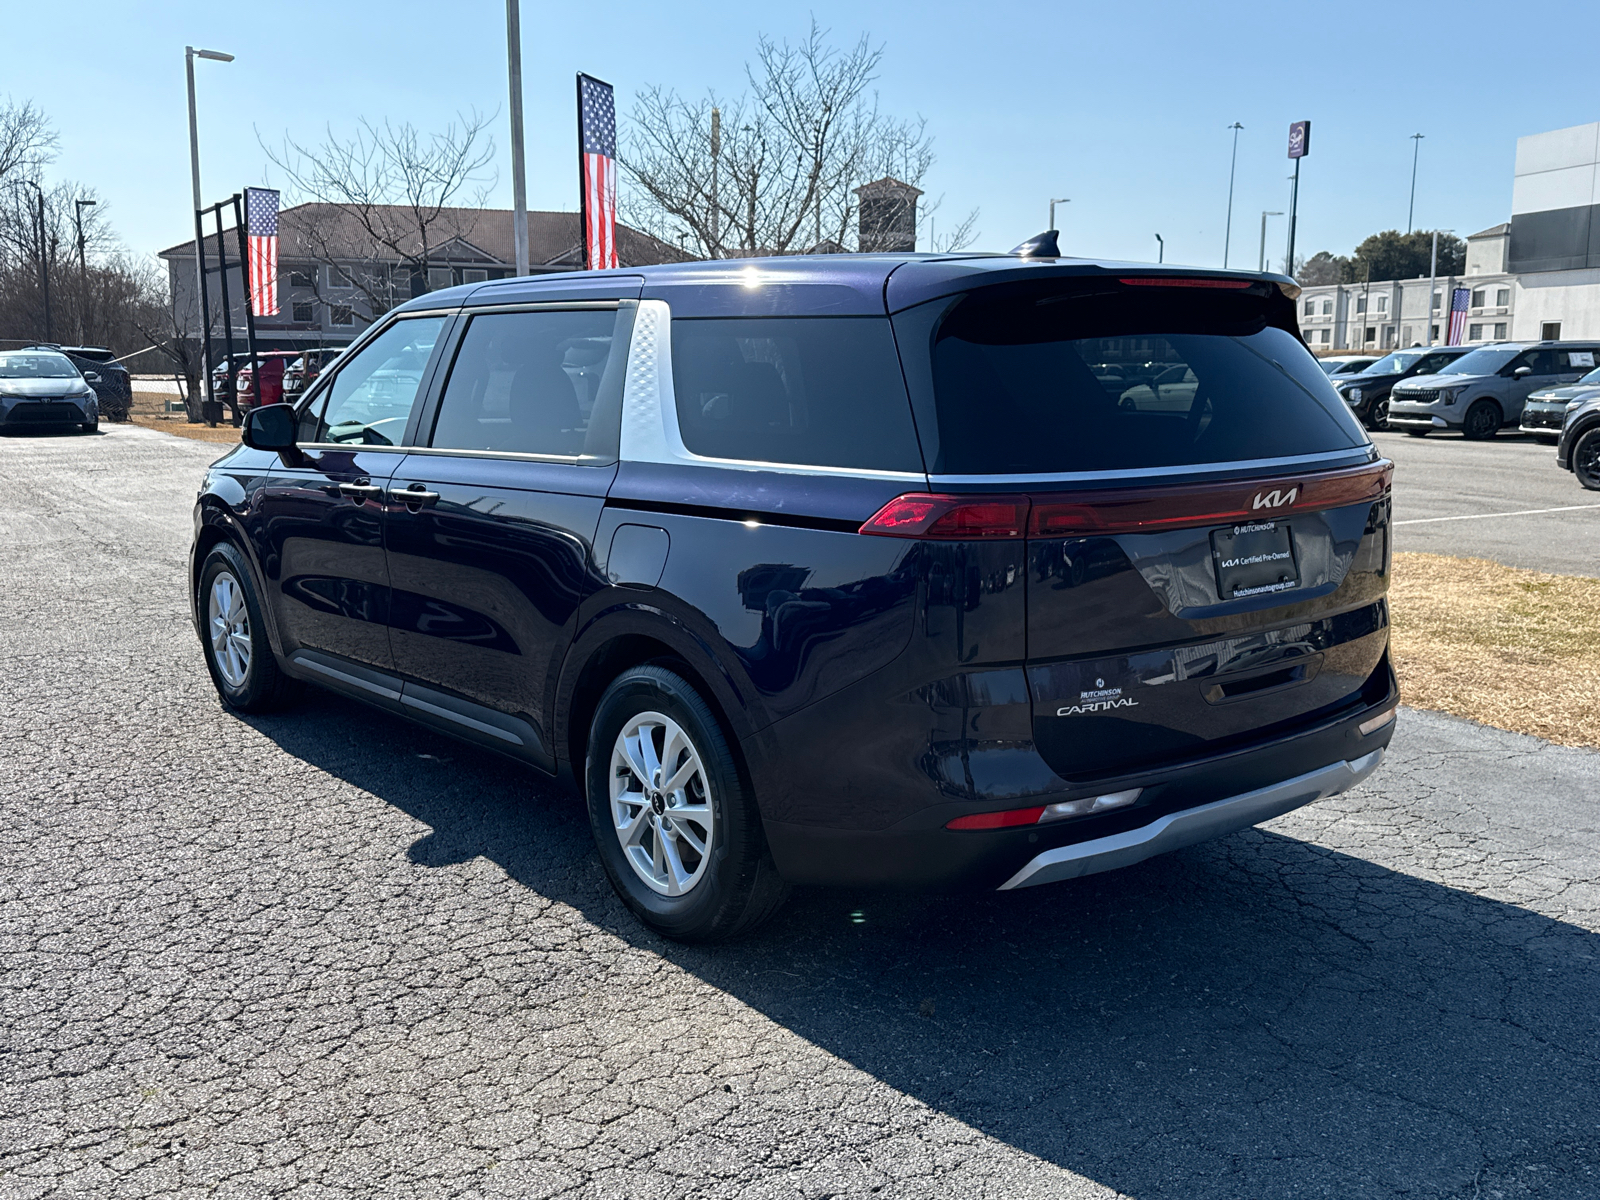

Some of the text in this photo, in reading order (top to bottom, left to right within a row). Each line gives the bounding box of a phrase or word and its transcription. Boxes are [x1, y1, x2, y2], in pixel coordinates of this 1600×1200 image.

[1252, 487, 1298, 510] KIA
[1240, 522, 1275, 534] HUTCHINSON
[1221, 551, 1290, 568] KIA Certified Pre-Owned
[1233, 581, 1296, 597] Hutchinsonautogroup.com
[1080, 688, 1122, 699] HUTCHINSON
[1056, 697, 1139, 716] CARNIVAL
